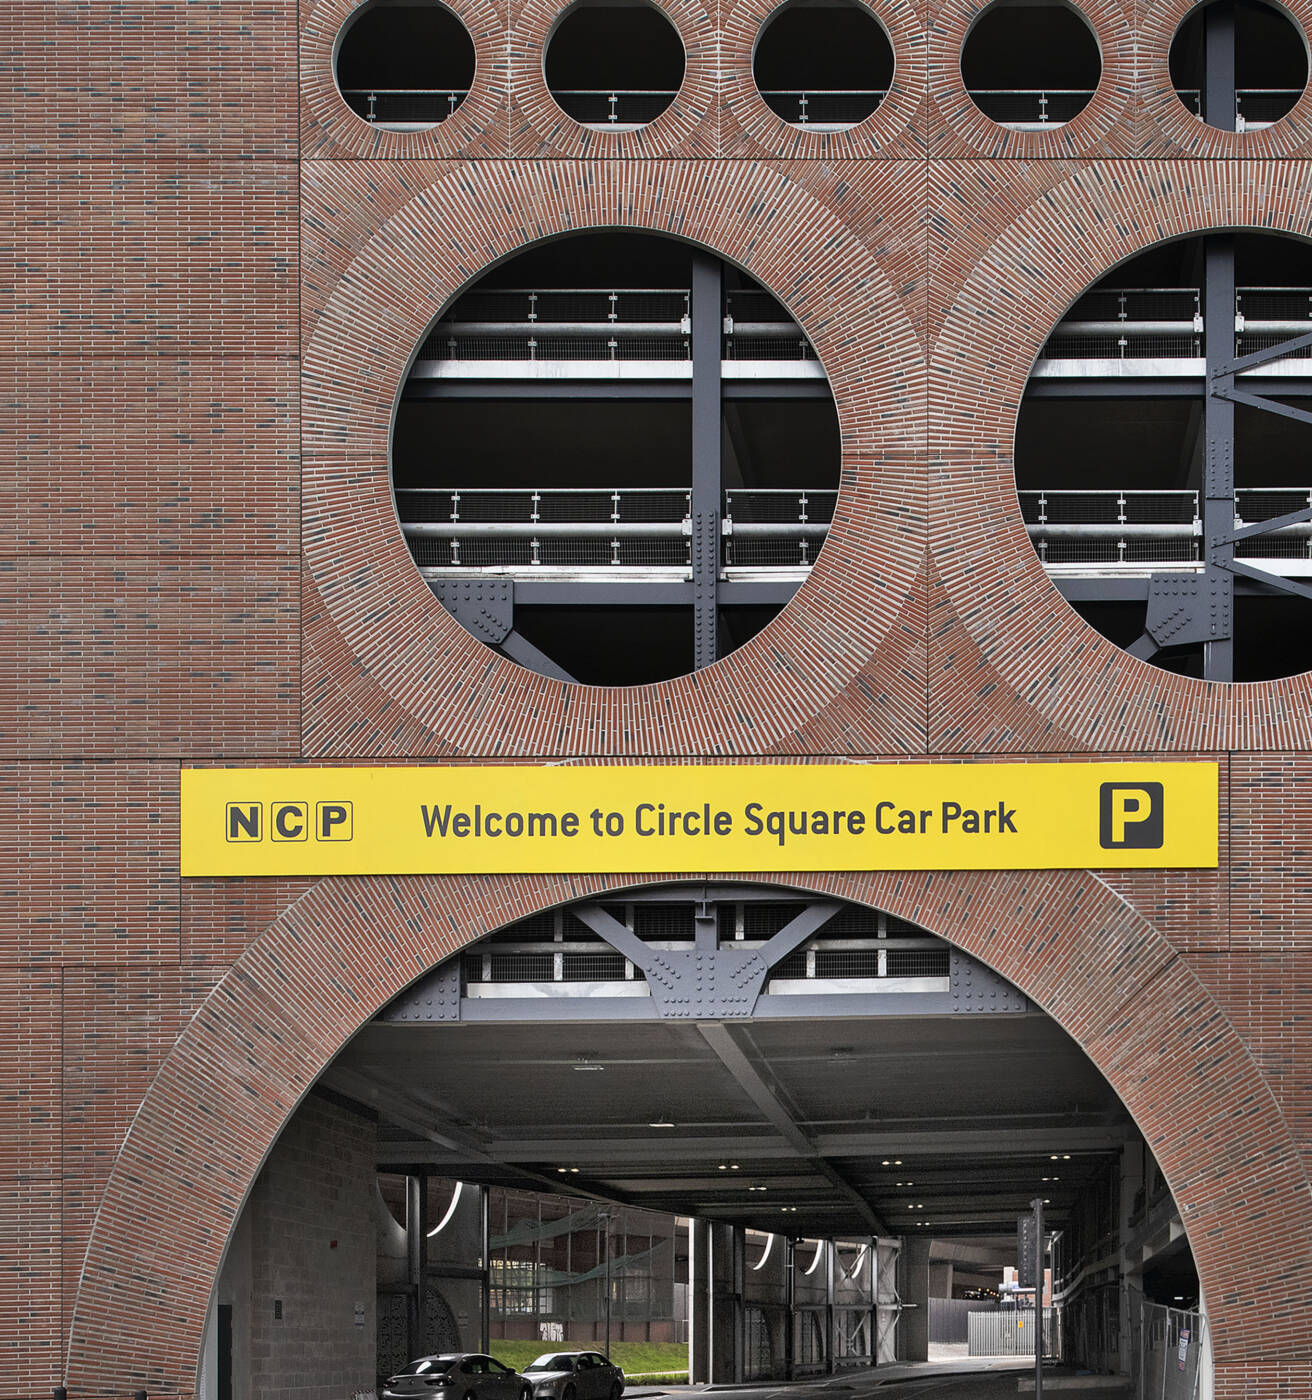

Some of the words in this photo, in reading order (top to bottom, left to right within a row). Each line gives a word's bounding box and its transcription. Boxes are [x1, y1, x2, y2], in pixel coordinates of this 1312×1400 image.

[229, 805, 347, 838] NCP
[420, 804, 580, 838] Welcome
[589, 808, 624, 837] to
[635, 803, 733, 836] Circle
[744, 802, 866, 847] Square
[875, 801, 933, 835] Car
[941, 801, 1018, 834] Park
[1111, 788, 1151, 843] P
